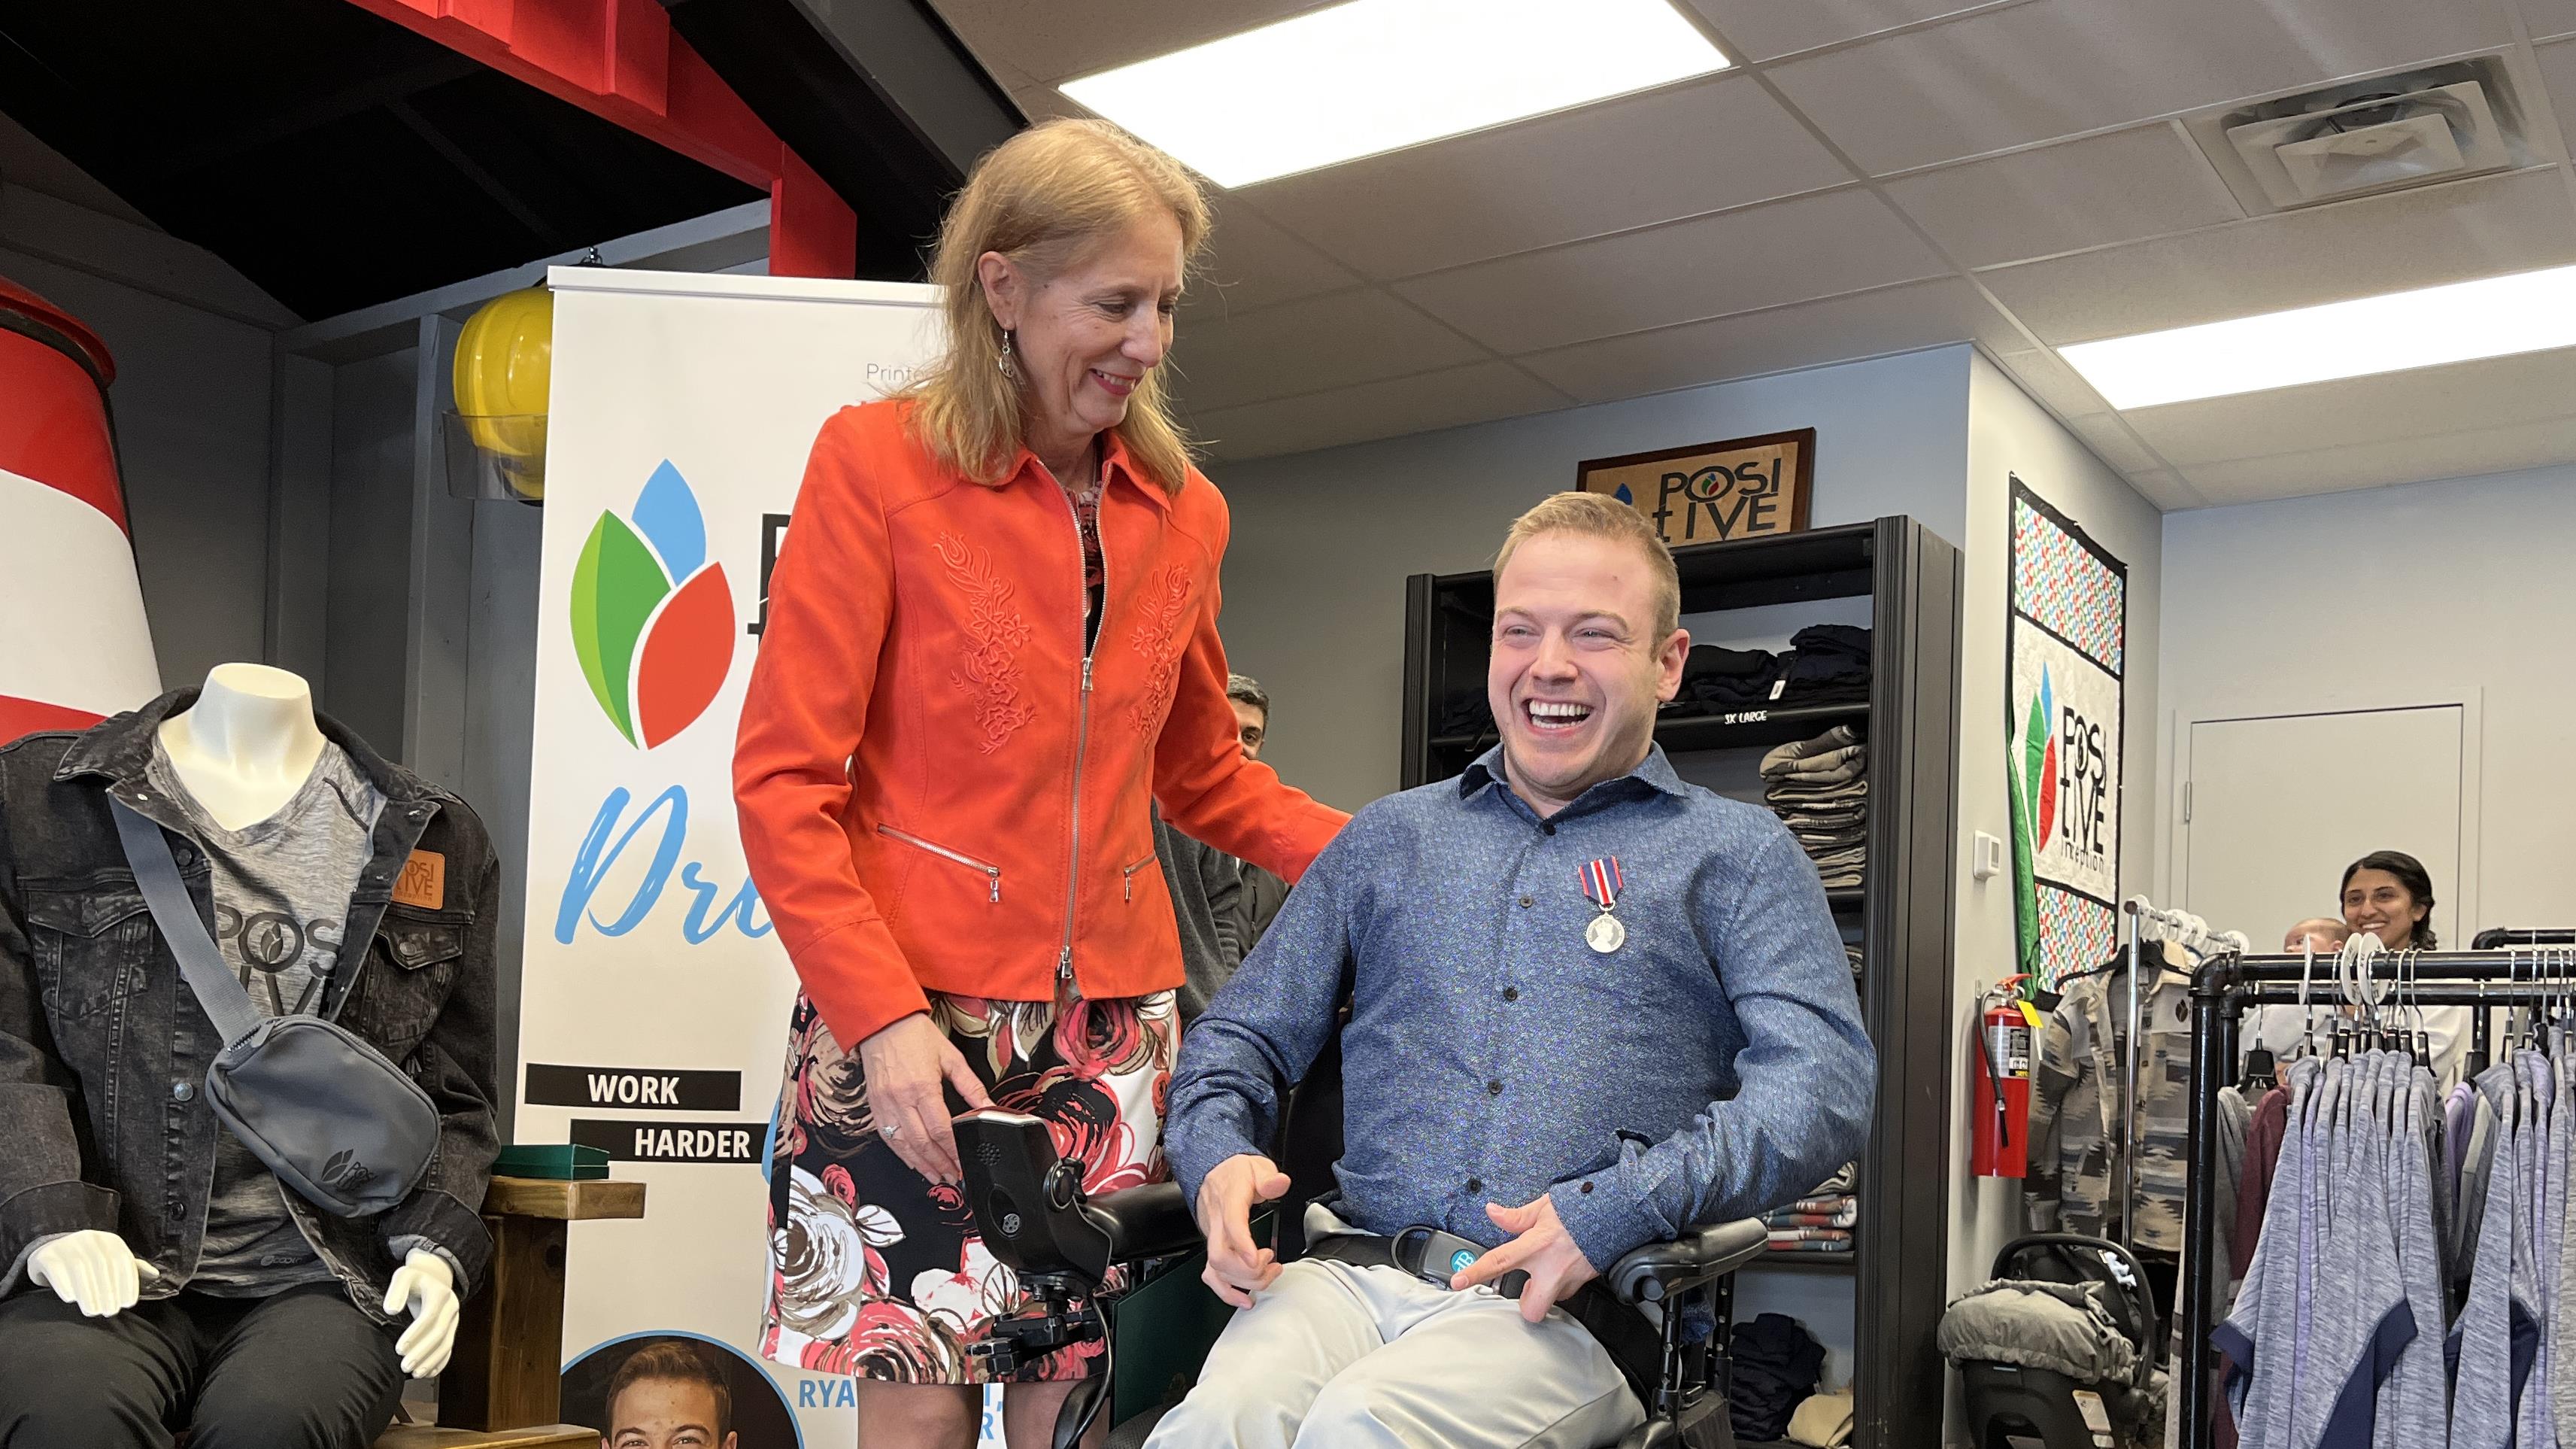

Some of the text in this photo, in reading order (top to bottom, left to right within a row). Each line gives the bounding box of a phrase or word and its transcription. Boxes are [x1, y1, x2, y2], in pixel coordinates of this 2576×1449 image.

[1659, 458, 1781, 506] POSI
[1739, 710, 1767, 723] LARGE
[587, 1074, 680, 1104] WORK
[634, 1129, 751, 1159] HARDER
